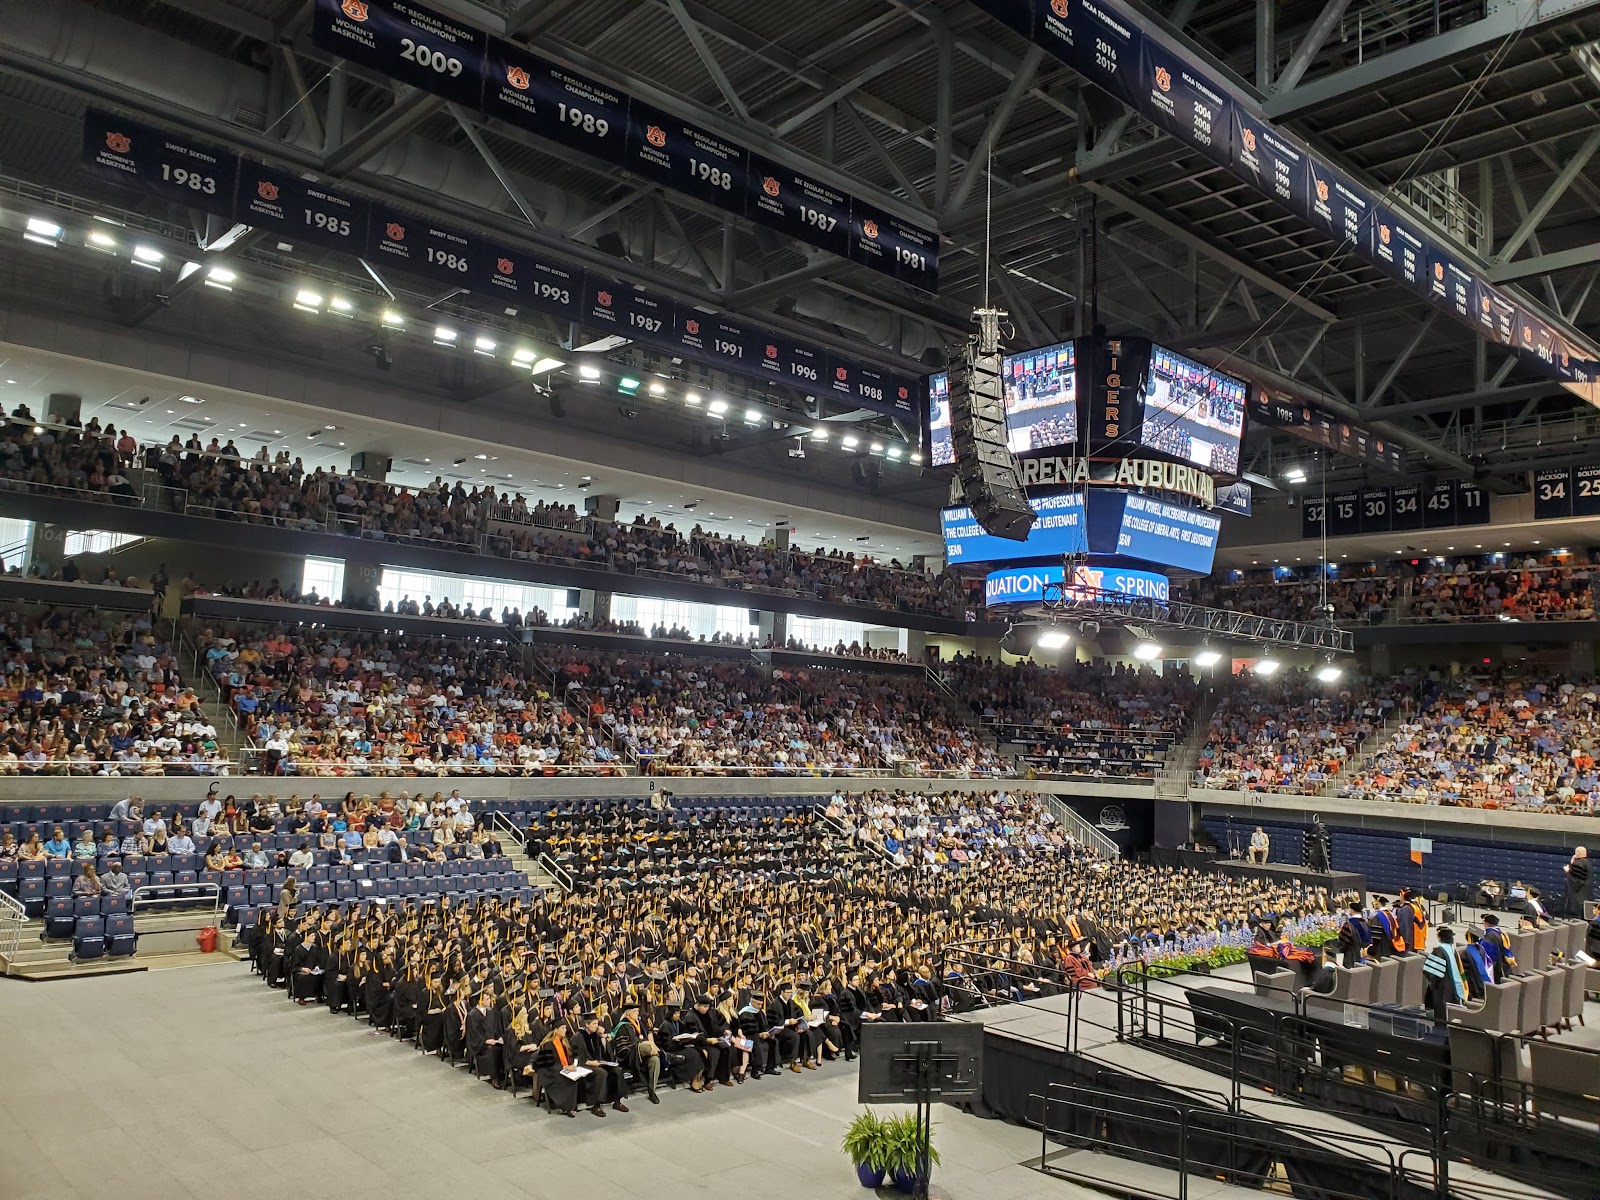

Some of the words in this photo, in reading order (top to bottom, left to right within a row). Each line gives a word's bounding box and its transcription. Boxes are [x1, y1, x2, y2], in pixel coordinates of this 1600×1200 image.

[335, 17, 374, 40] WOMEN'S
[392, 2, 407, 14] SEC
[408, 9, 442, 29] REGULAR
[443, 23, 474, 42] SEASON
[1046, 13, 1073, 37] WOMEN'S
[1082, 0, 1097, 15] NCAA
[1097, 9, 1131, 40] TOURNAMENT
[331, 24, 376, 49] BASKETBALL
[410, 18, 457, 43] CHAMPIONS
[1044, 21, 1074, 47] BASKETBALL
[399, 38, 463, 78] 2009
[1095, 37, 1117, 60] 2016
[1095, 52, 1117, 74] 2017
[502, 86, 535, 105] WOMEN'S
[550, 70, 563, 80] SEC
[563, 75, 593, 93] REGULAR
[593, 88, 619, 104] SEASON
[564, 84, 604, 106] CHAMPIONS
[1181, 71, 1196, 87] NCAA
[1195, 80, 1224, 106] TOURNAMENT
[498, 93, 537, 114] BASKETBALL
[1150, 95, 1176, 117] BASKETBALL
[1151, 88, 1174, 108] WOMEN'S
[558, 102, 609, 138] 1989
[1193, 100, 1212, 121] 2004
[1193, 114, 1211, 134] 2008
[682, 127, 693, 137] SEC
[693, 132, 718, 148] REGULAR
[718, 143, 740, 158] SEASON
[1193, 128, 1212, 147] 2009
[100, 150, 135, 166] WOMEN'S
[165, 142, 188, 154] SWEET
[188, 150, 217, 164] SIXTEEN
[642, 145, 670, 161] WOMEN'S
[694, 140, 728, 160] CHAMPIONS
[96, 156, 138, 174] BASKETBALL
[639, 151, 672, 170] BASKETBALL
[1275, 158, 1290, 175] 1997
[161, 163, 216, 195] 1983
[689, 157, 732, 191] 1988
[1275, 170, 1290, 188] 1999
[307, 189, 327, 200] SWEET
[327, 195, 351, 208] SIXTEEN
[1275, 182, 1291, 200] 2000
[249, 204, 285, 220] BASKETBALL
[253, 199, 283, 212] WOMEN'S
[304, 208, 350, 236] 1985
[800, 205, 837, 233] 1987
[382, 239, 408, 252] WOMEN'S
[429, 228, 447, 239] SWEET
[446, 234, 468, 246] SIXTEEN
[379, 244, 410, 258] BASKETBALL
[427, 247, 469, 273] 1986
[895, 245, 926, 272] 1981
[533, 280, 570, 305] 1993
[629, 311, 663, 333] 1987
[714, 338, 743, 359] 1991
[791, 362, 817, 381] 1996
[858, 383, 883, 401] 1988
[1105, 340, 1121, 438] TIGERS
[1276, 406, 1293, 423] 1985
[1115, 457, 1199, 493] AUBURN
[1536, 472, 1569, 482] JACKSON
[1363, 491, 1387, 499] MITCHELL
[1394, 487, 1418, 496] BARKLEY
[1540, 482, 1566, 501] 34
[1578, 479, 1600, 497] 25
[943, 508, 967, 522] WILLIAM
[1041, 494, 1076, 510] PROFESSOR
[1075, 492, 1084, 506] IN
[1232, 497, 1247, 508] 2018
[1365, 500, 1386, 517] 30
[1396, 496, 1418, 514] 34
[1427, 493, 1450, 510] 45
[1465, 490, 1481, 508] 11
[1126, 495, 1146, 511] WILLIAM
[1187, 511, 1196, 526] AND
[1195, 513, 1216, 531] PROFESSOR
[1307, 506, 1326, 522] 32
[1337, 503, 1354, 519] 15
[39, 528, 64, 542] 104
[945, 526, 957, 539] THE
[956, 524, 980, 538] COLLEGE
[1042, 513, 1078, 529] LIEUTENANT
[1122, 513, 1132, 528] THE
[1131, 516, 1150, 533] COLLEGE
[1148, 520, 1156, 533] OF
[1154, 522, 1170, 538] LIBERAL
[1180, 529, 1192, 543] FIRST
[1190, 532, 1214, 548] LIEUTENANT
[1118, 532, 1131, 547] SEAN
[947, 543, 963, 557] SEAN
[360, 566, 378, 578] 103
[986, 573, 1049, 597] DUATION
[1115, 575, 1166, 600] SPRING
[596, 595, 611, 605] 102
[649, 780, 656, 791] B
[927, 782, 934, 790] A
[1255, 796, 1262, 804] N
